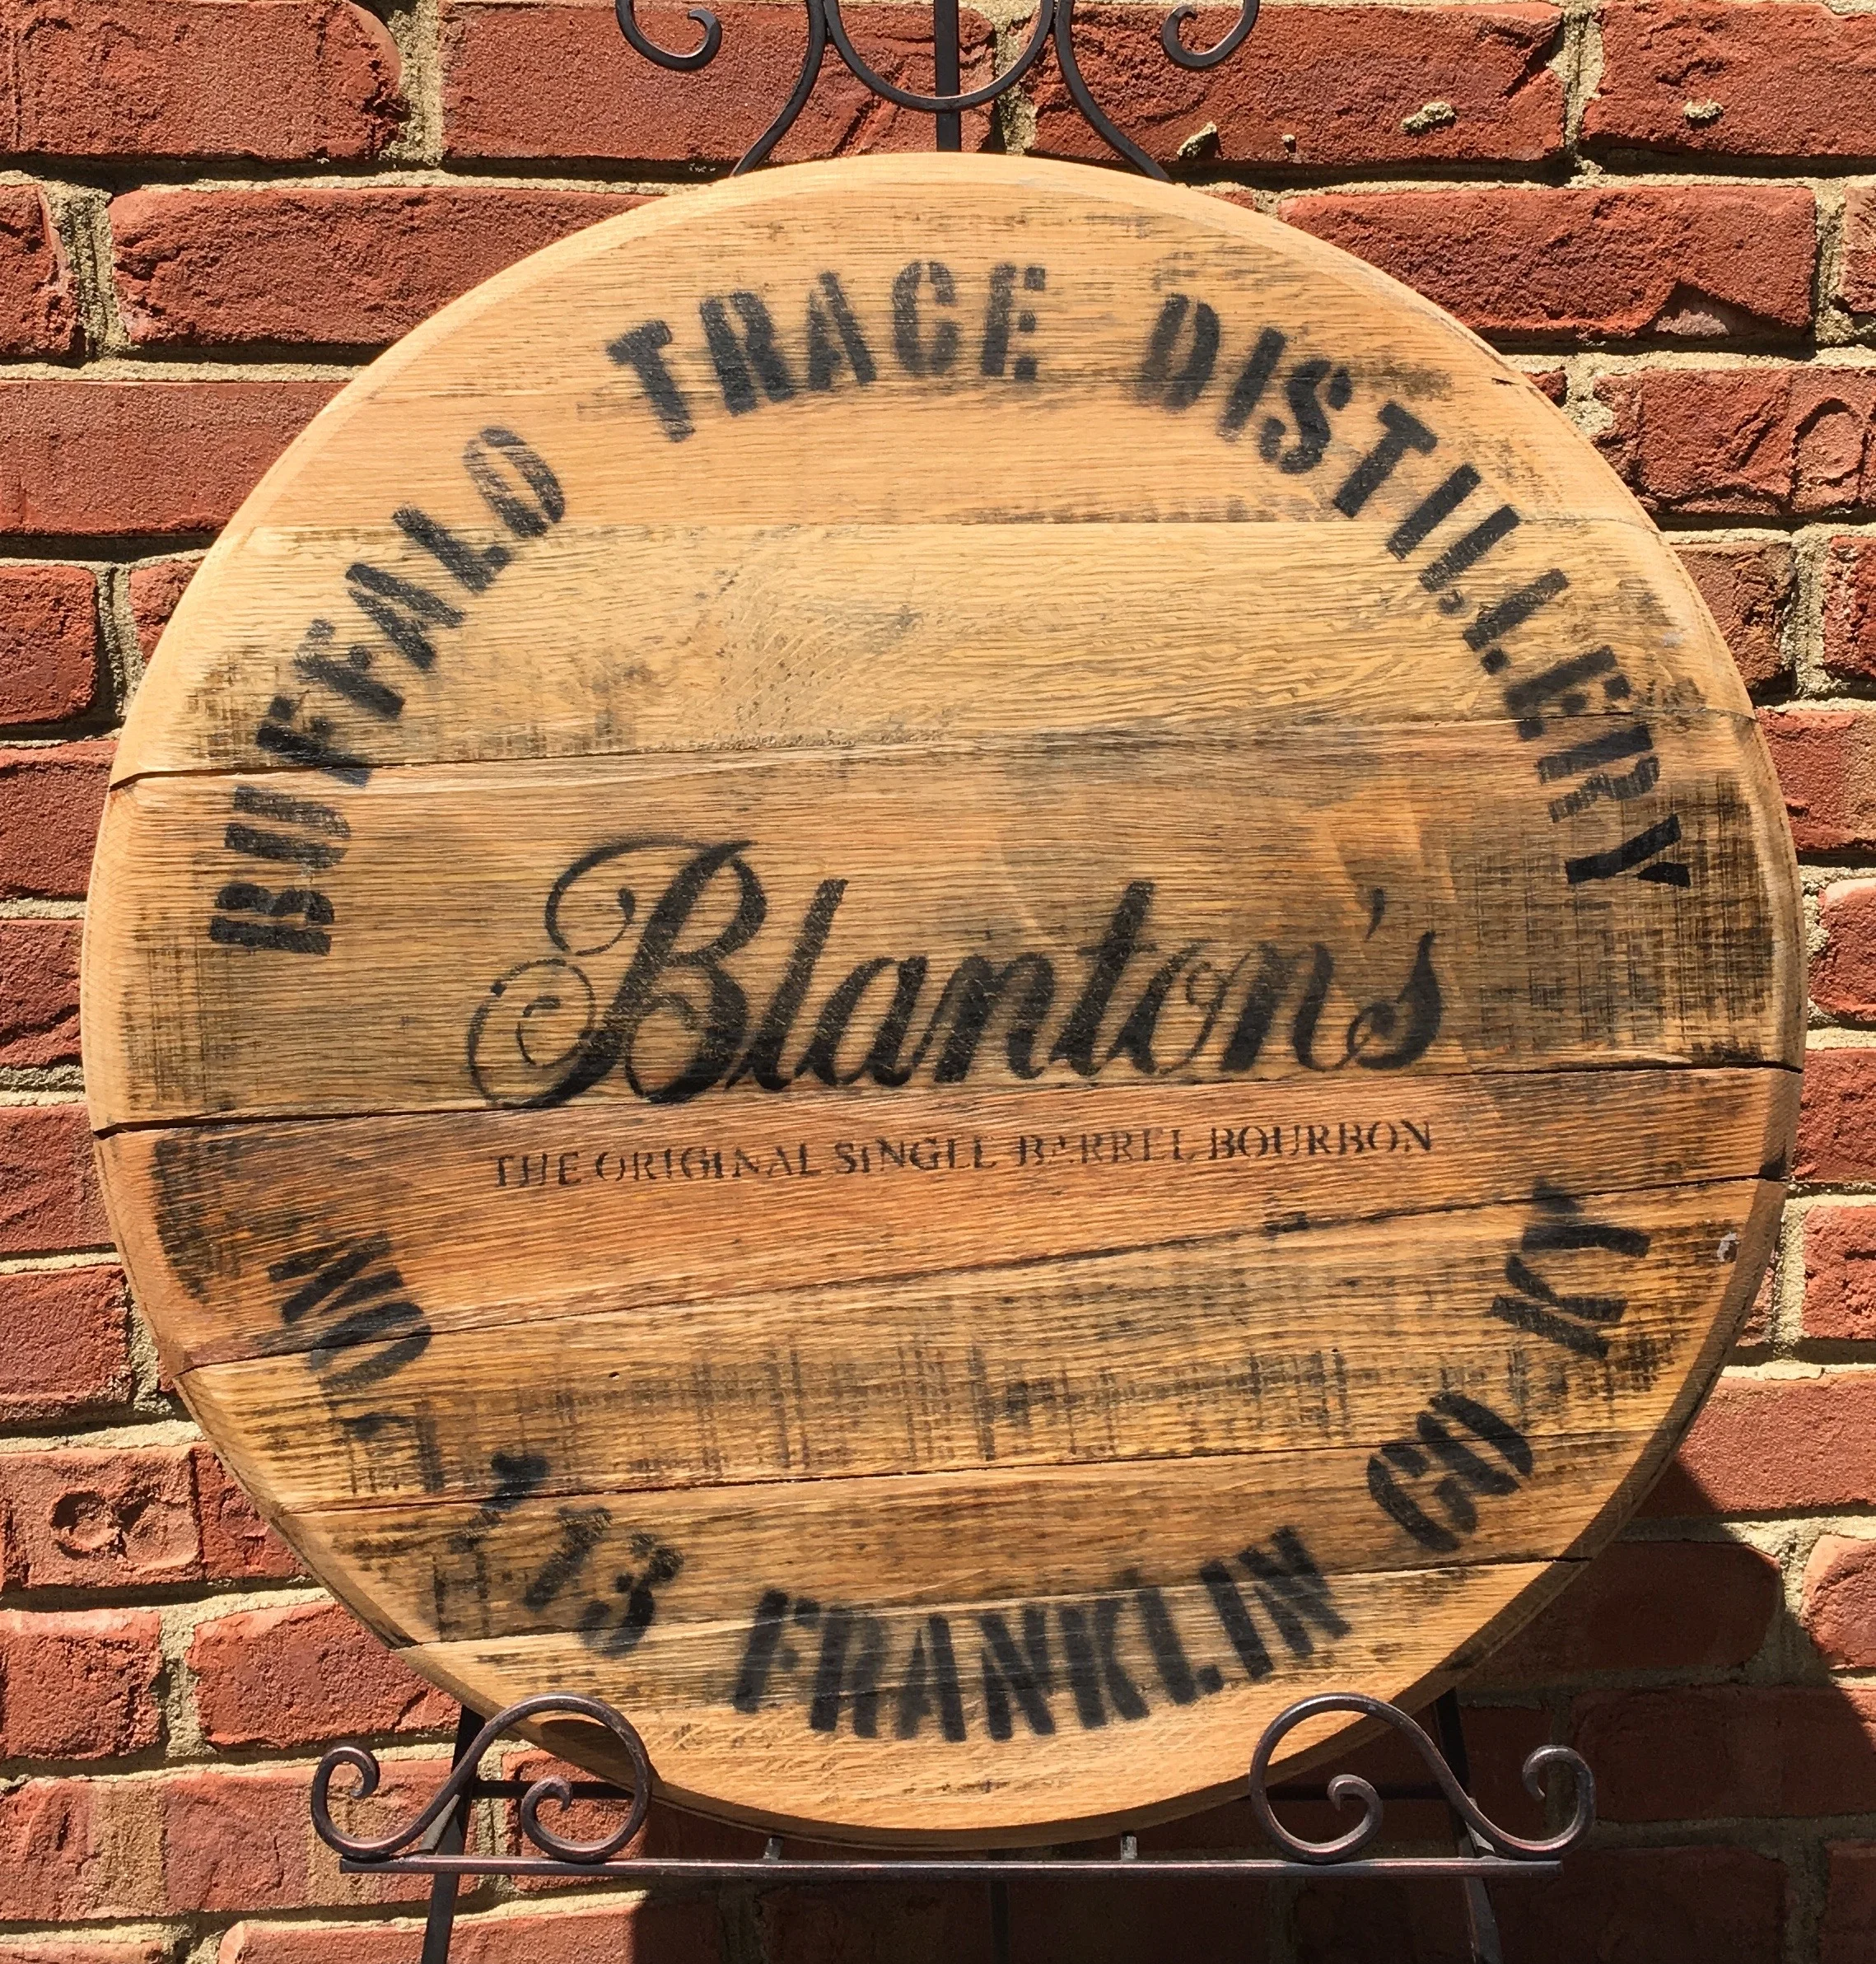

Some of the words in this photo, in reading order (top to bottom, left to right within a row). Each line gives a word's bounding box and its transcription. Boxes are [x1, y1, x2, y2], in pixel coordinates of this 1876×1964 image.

[209, 426, 565, 955] BUFFALO
[606, 259, 1045, 442] TRACE
[1137, 293, 1690, 888] DISTILLERY
[465, 837, 1442, 1108] Blanton's
[494, 1150, 581, 1187] THE
[595, 1141, 823, 1182] ORIGINAL
[1207, 1118, 1431, 1160] BOURBON
[733, 1525, 1351, 1741] FRANKLIN
[1366, 1392, 1533, 1553] CO
[1489, 1176, 1650, 1360] KY
